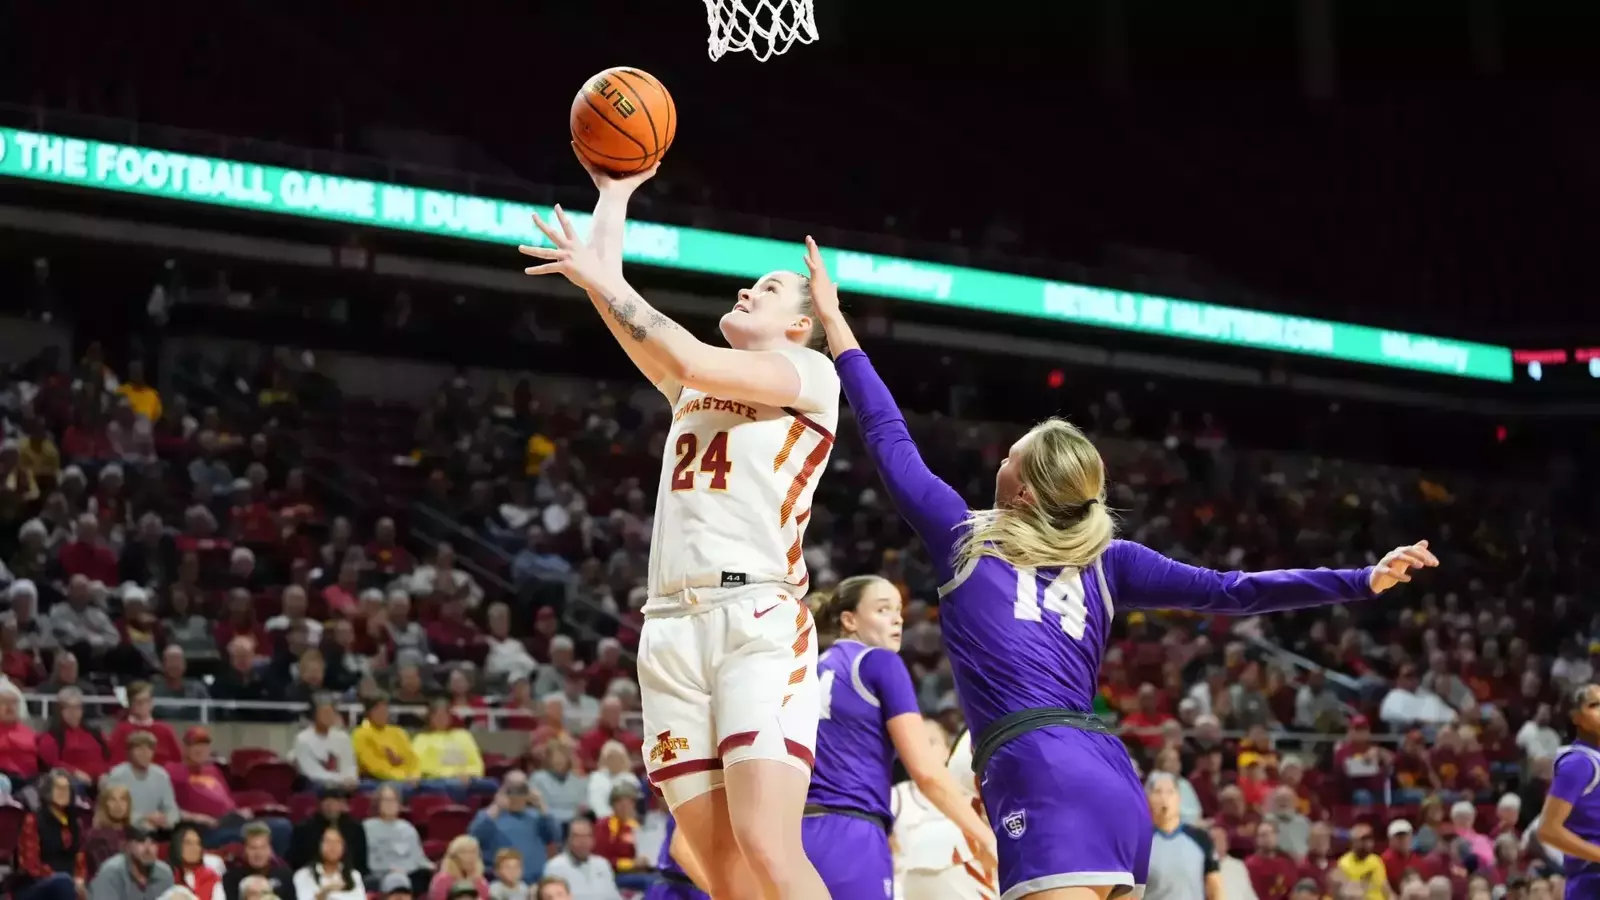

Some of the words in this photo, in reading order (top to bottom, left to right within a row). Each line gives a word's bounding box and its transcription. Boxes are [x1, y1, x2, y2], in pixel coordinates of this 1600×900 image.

[15, 132, 87, 178] THE
[96, 144, 273, 203] FOOTBALL
[279, 171, 376, 219] GAME
[383, 188, 415, 222] IN
[703, 396, 757, 421] STATE
[671, 431, 732, 491] 24
[1013, 566, 1087, 640] 14
[649, 737, 689, 762] STATE
